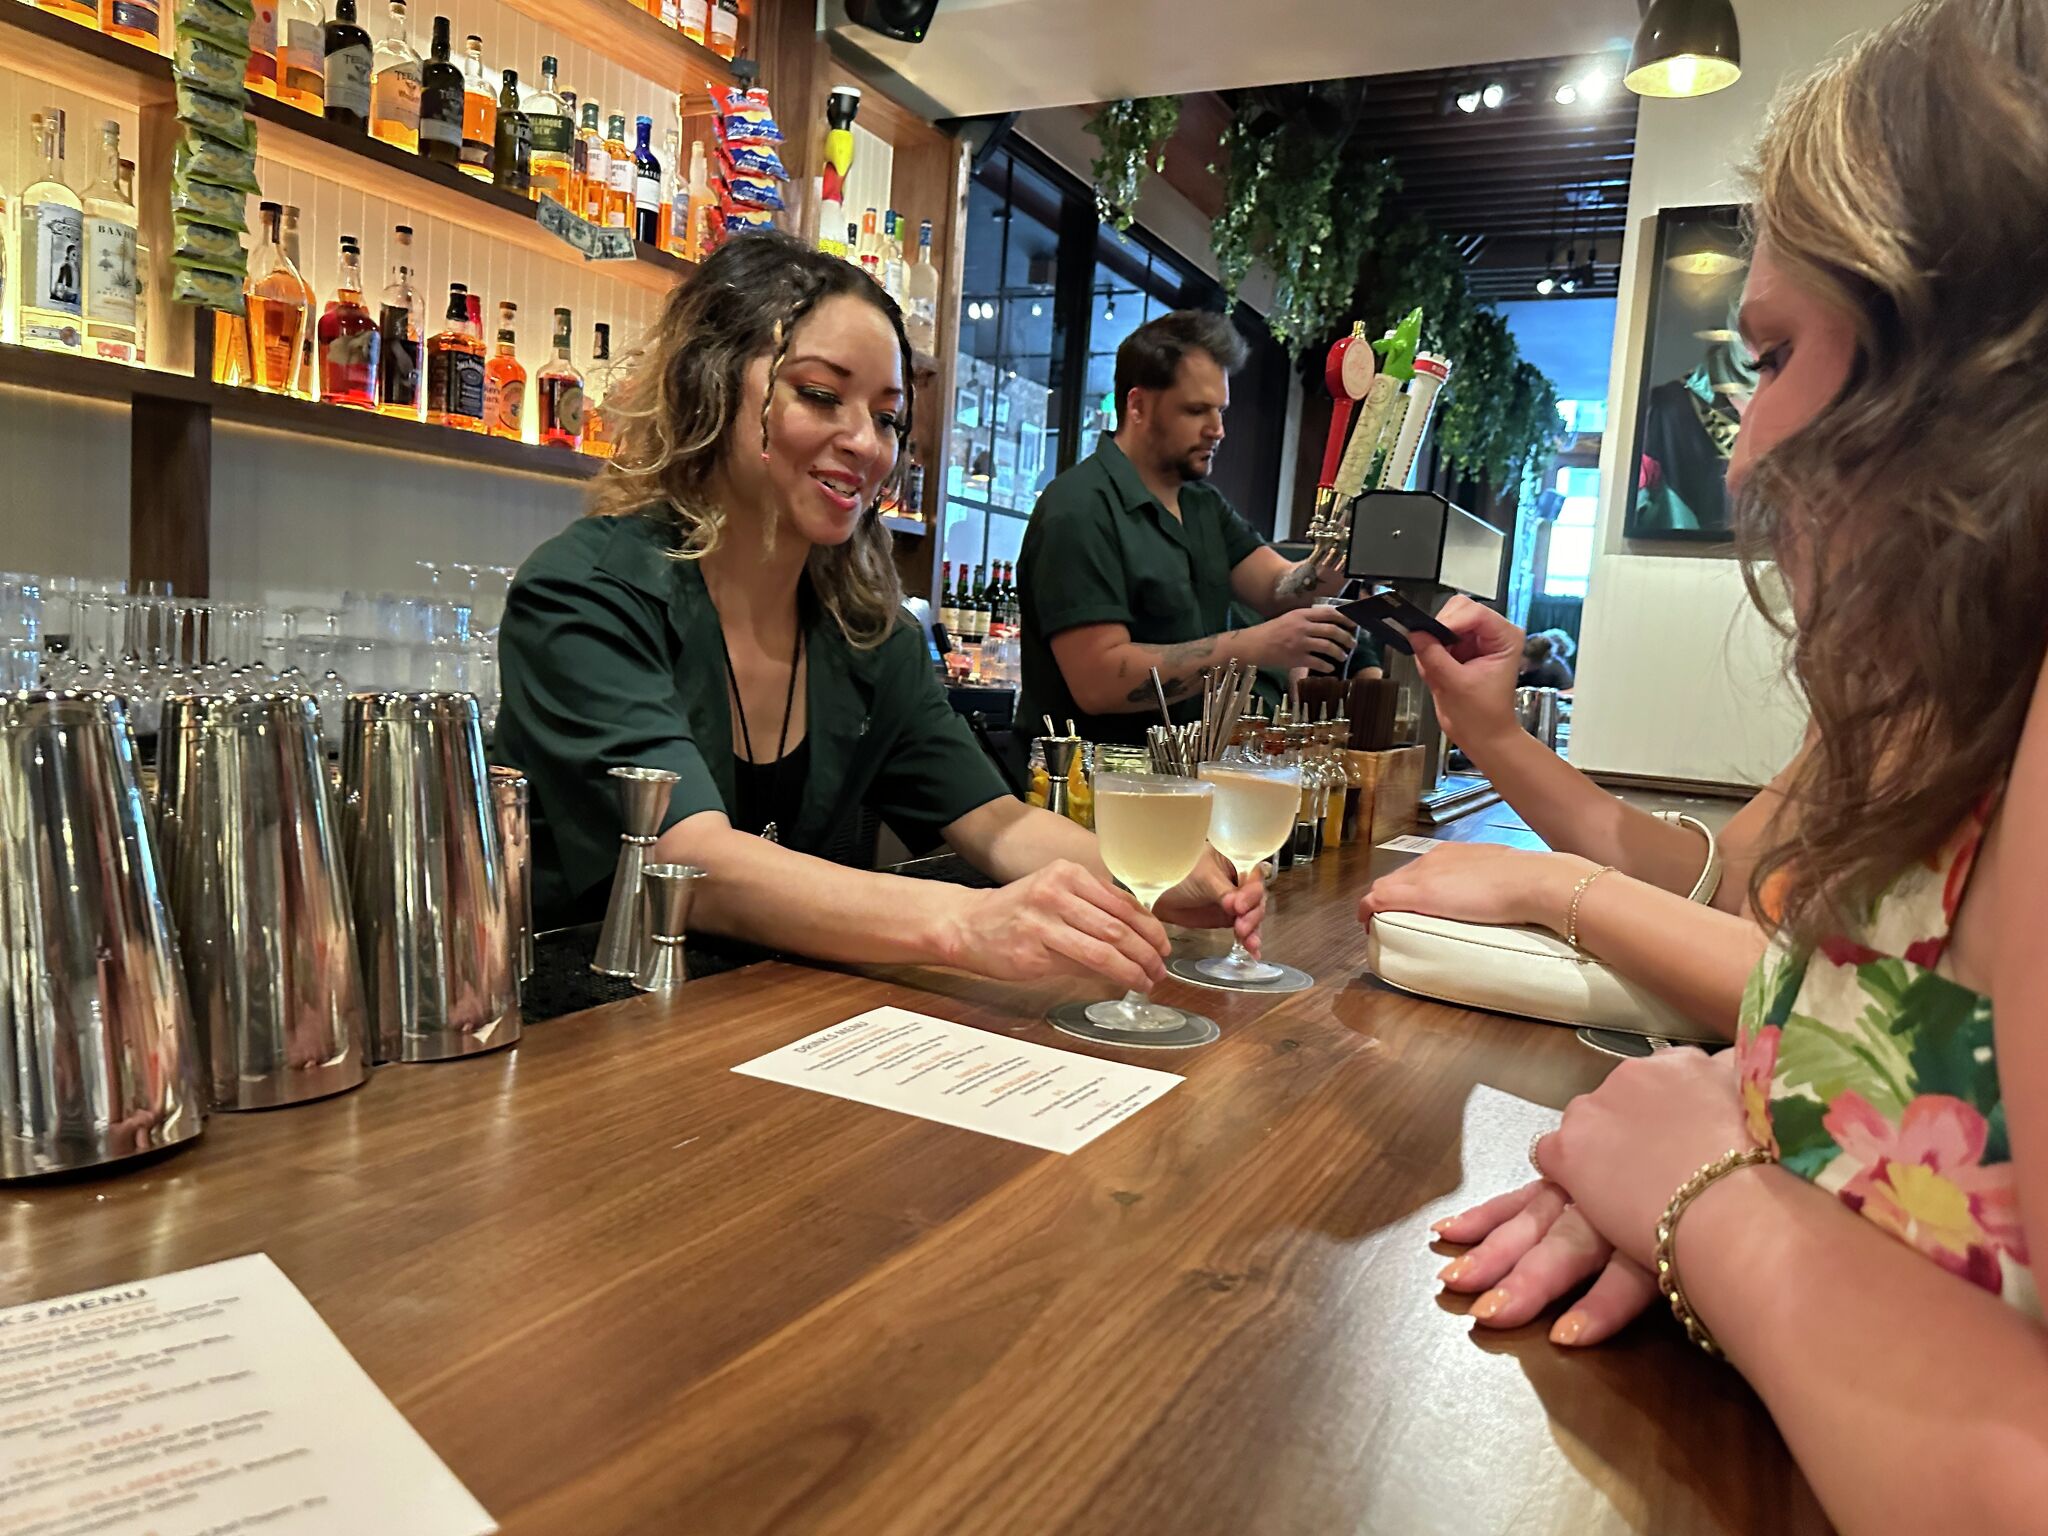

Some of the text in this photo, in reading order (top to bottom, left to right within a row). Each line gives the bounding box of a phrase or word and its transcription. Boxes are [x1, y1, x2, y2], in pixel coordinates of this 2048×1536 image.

[793, 1034, 838, 1053] DRINKS
[834, 1021, 869, 1035] MENU
[47, 1288, 148, 1317] MENU
